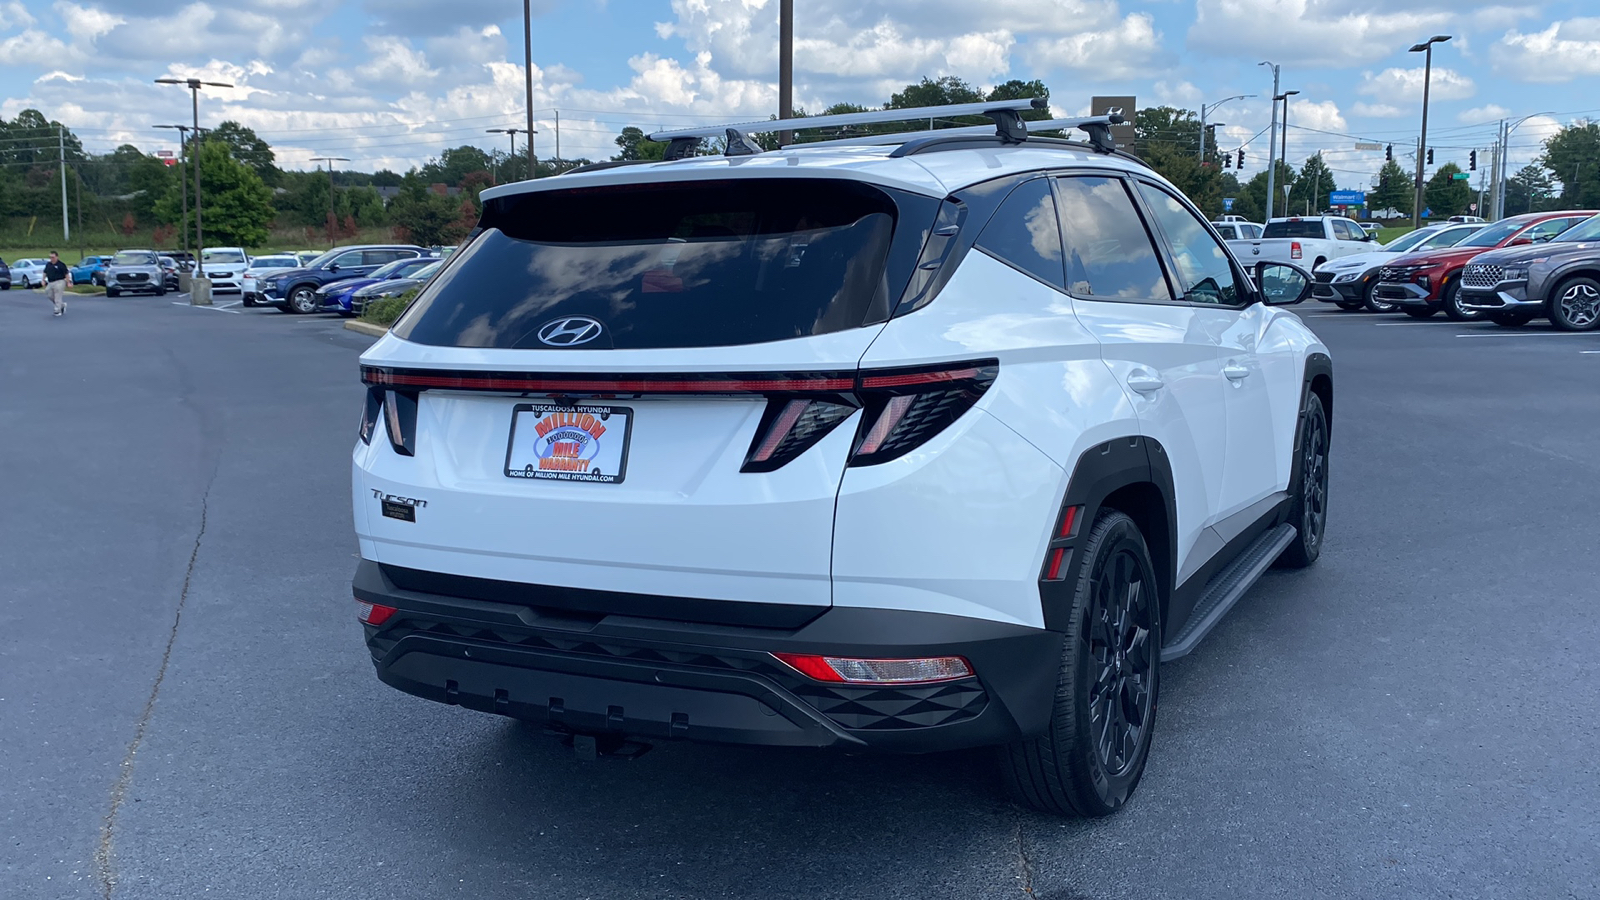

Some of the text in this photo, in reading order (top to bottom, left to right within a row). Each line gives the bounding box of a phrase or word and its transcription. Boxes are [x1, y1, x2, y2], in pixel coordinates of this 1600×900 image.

[531, 404, 611, 414] TUSCALOOSA HYUNDAI
[534, 412, 607, 440] MILLION
[552, 442, 581, 458] MILE
[538, 457, 591, 473] WARRANTY
[509, 470, 526, 478] HOME
[534, 471, 558, 479] MILLION
[557, 472, 571, 480] MILE
